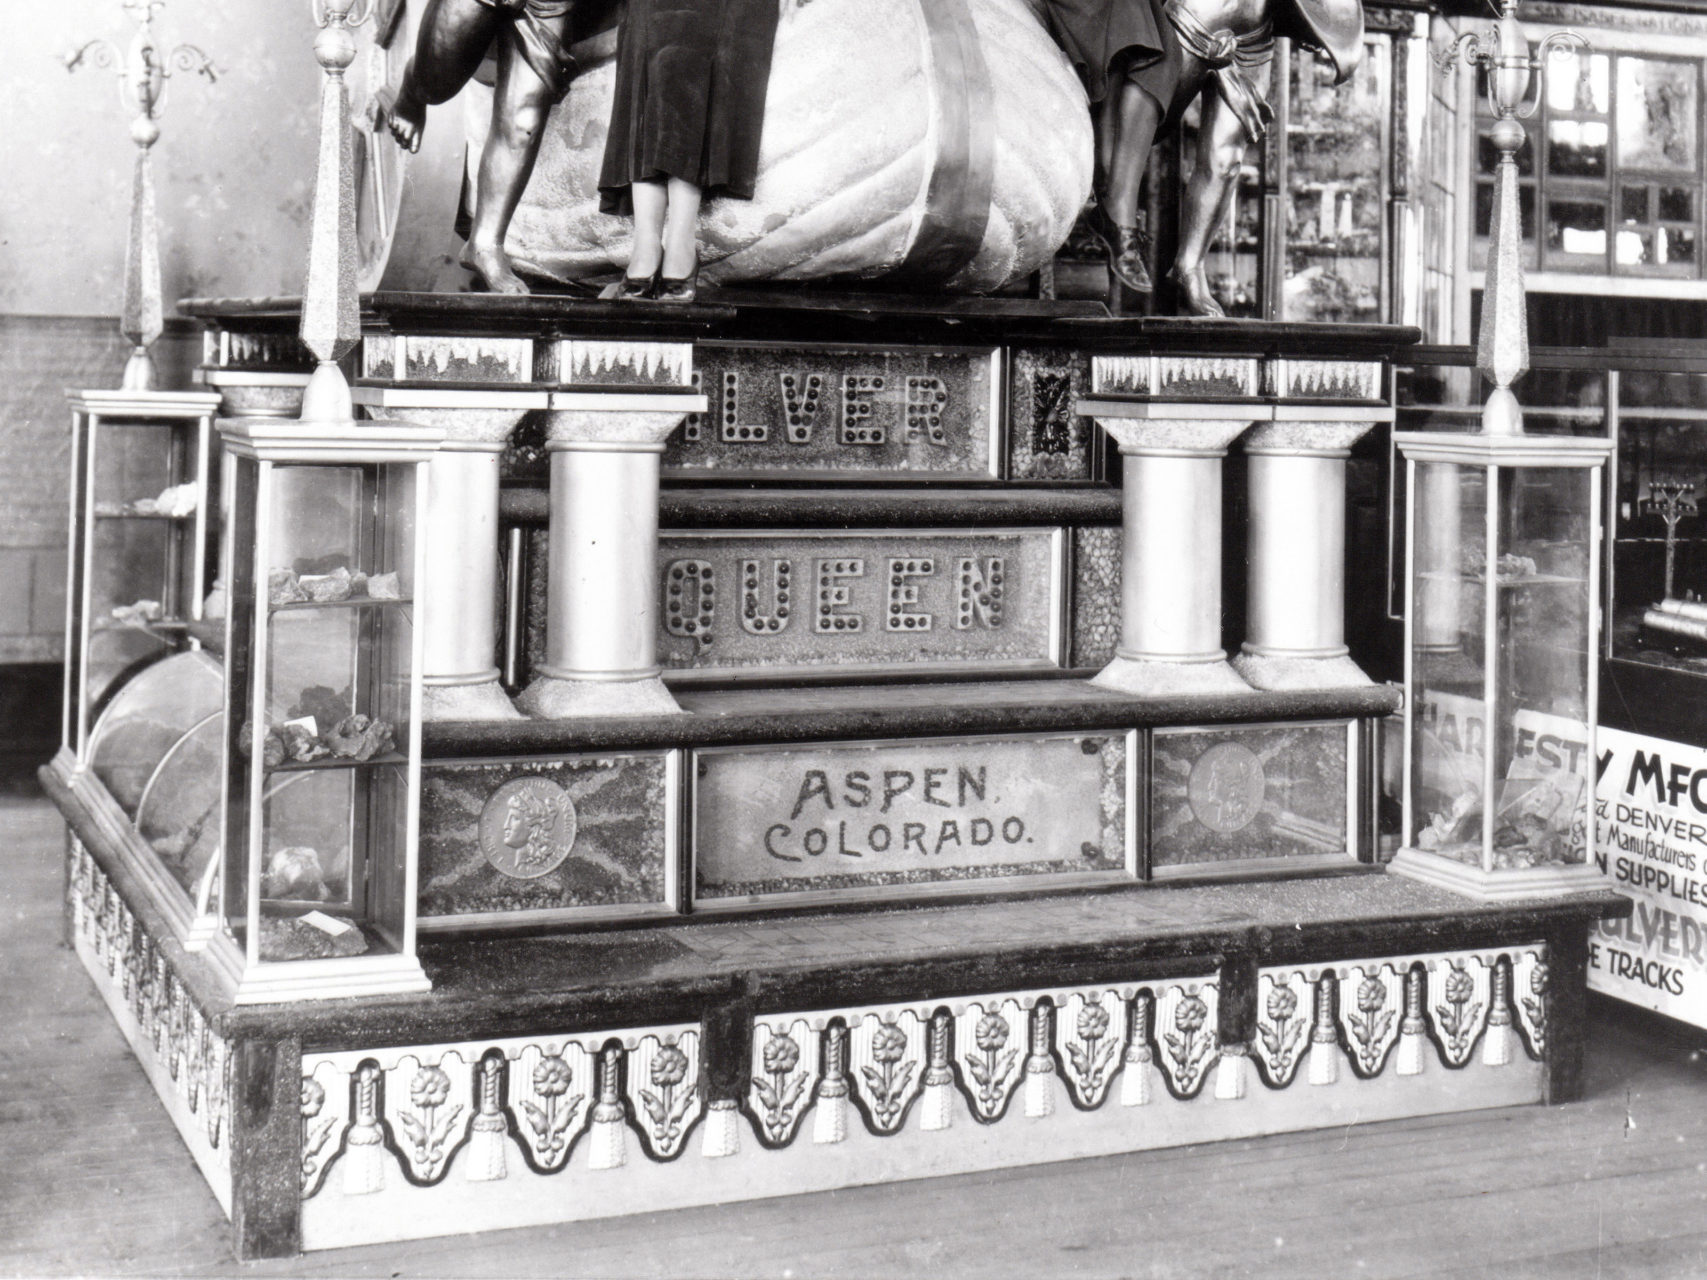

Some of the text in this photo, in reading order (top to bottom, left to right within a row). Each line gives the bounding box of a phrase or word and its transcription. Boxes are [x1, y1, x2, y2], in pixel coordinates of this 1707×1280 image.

[664, 557, 1003, 653] QUEEN
[764, 816, 1034, 862] COLORADO.
[1607, 823, 1697, 872] Manufacturers
[1607, 947, 1685, 996] TRACKS
